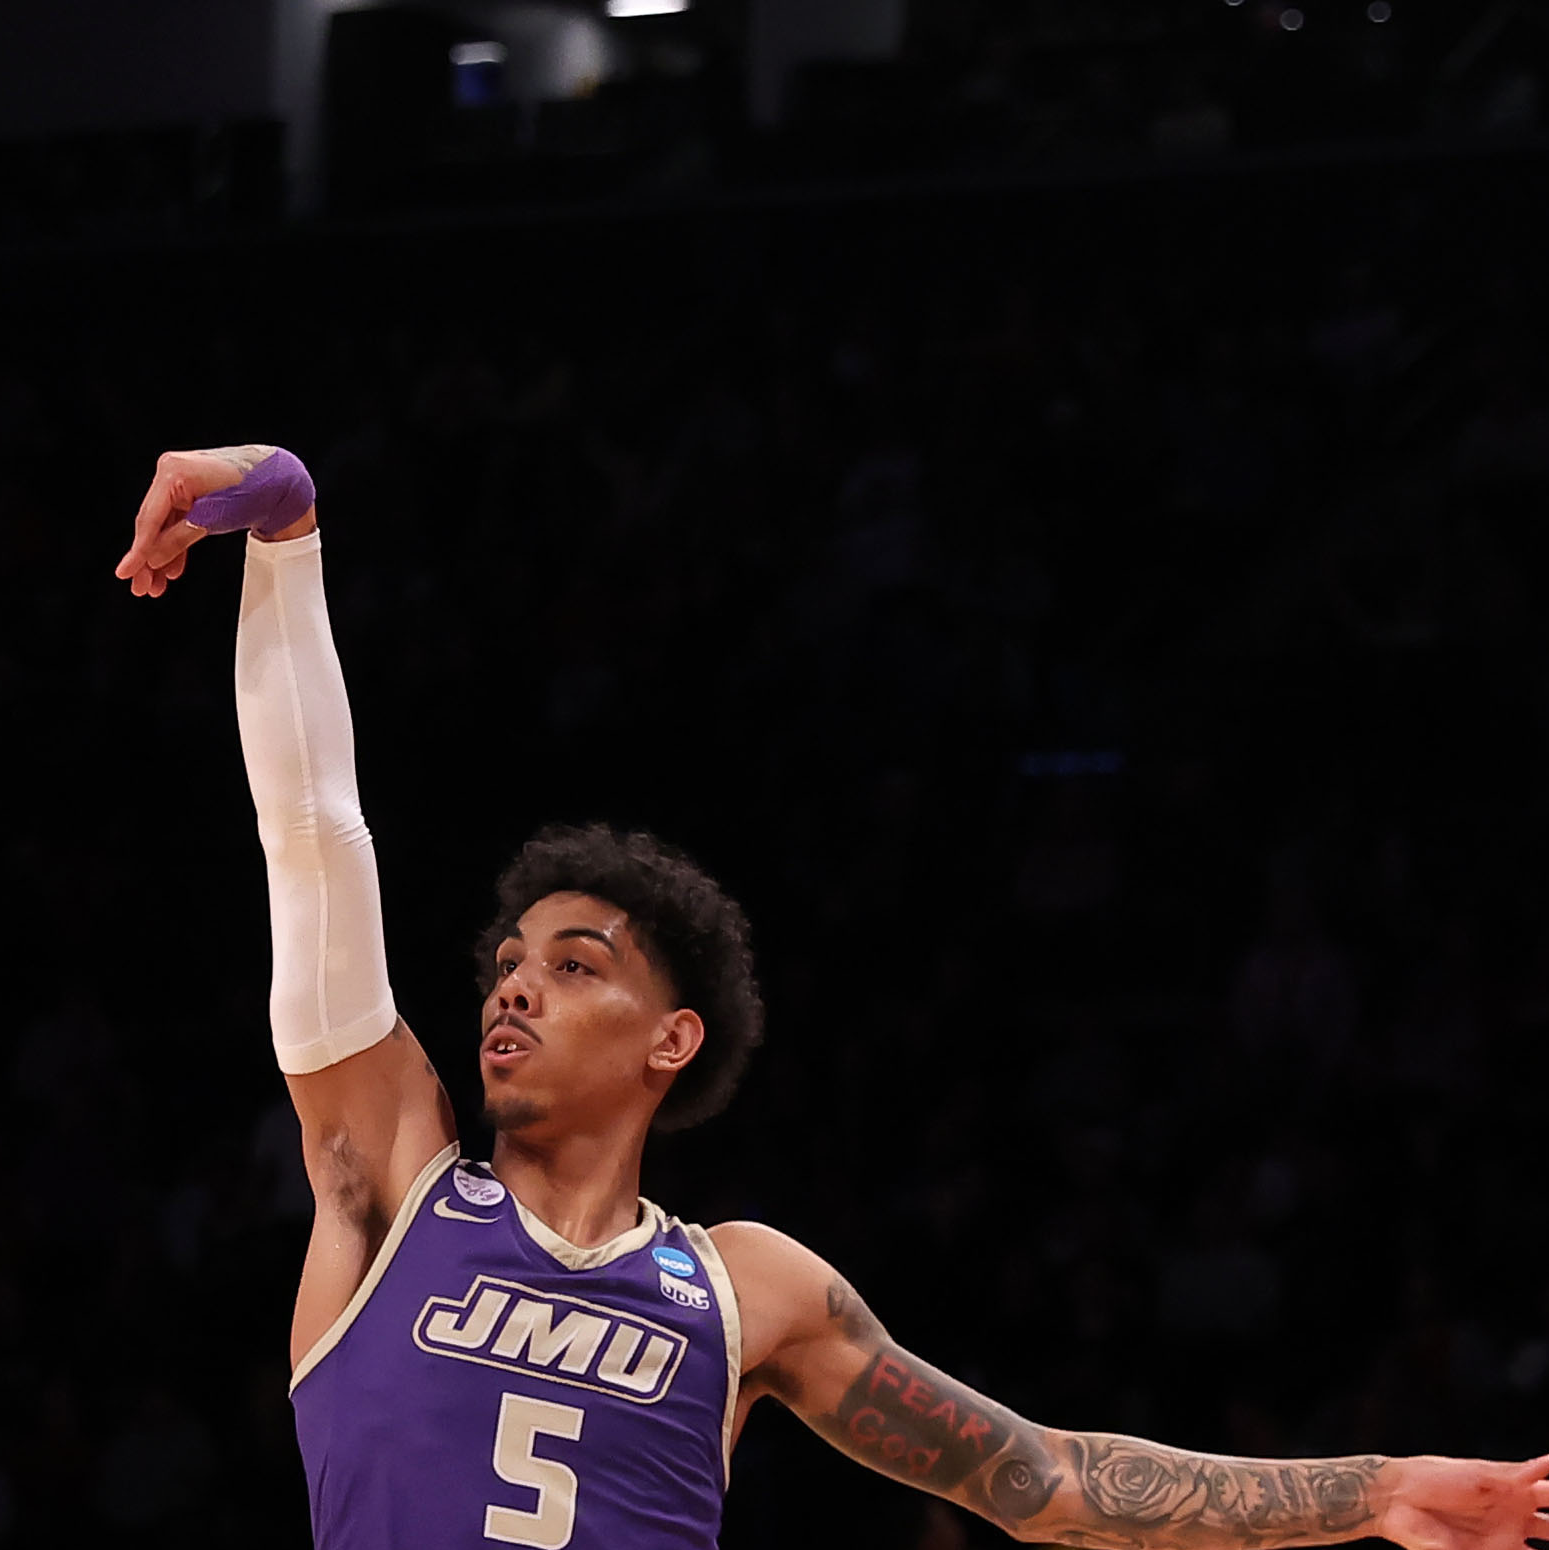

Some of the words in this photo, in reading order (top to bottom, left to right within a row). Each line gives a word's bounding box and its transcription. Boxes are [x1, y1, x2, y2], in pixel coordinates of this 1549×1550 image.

[656, 1255, 697, 1275] NCAA
[424, 1286, 677, 1394] JMU
[868, 1354, 994, 1452] FEAR
